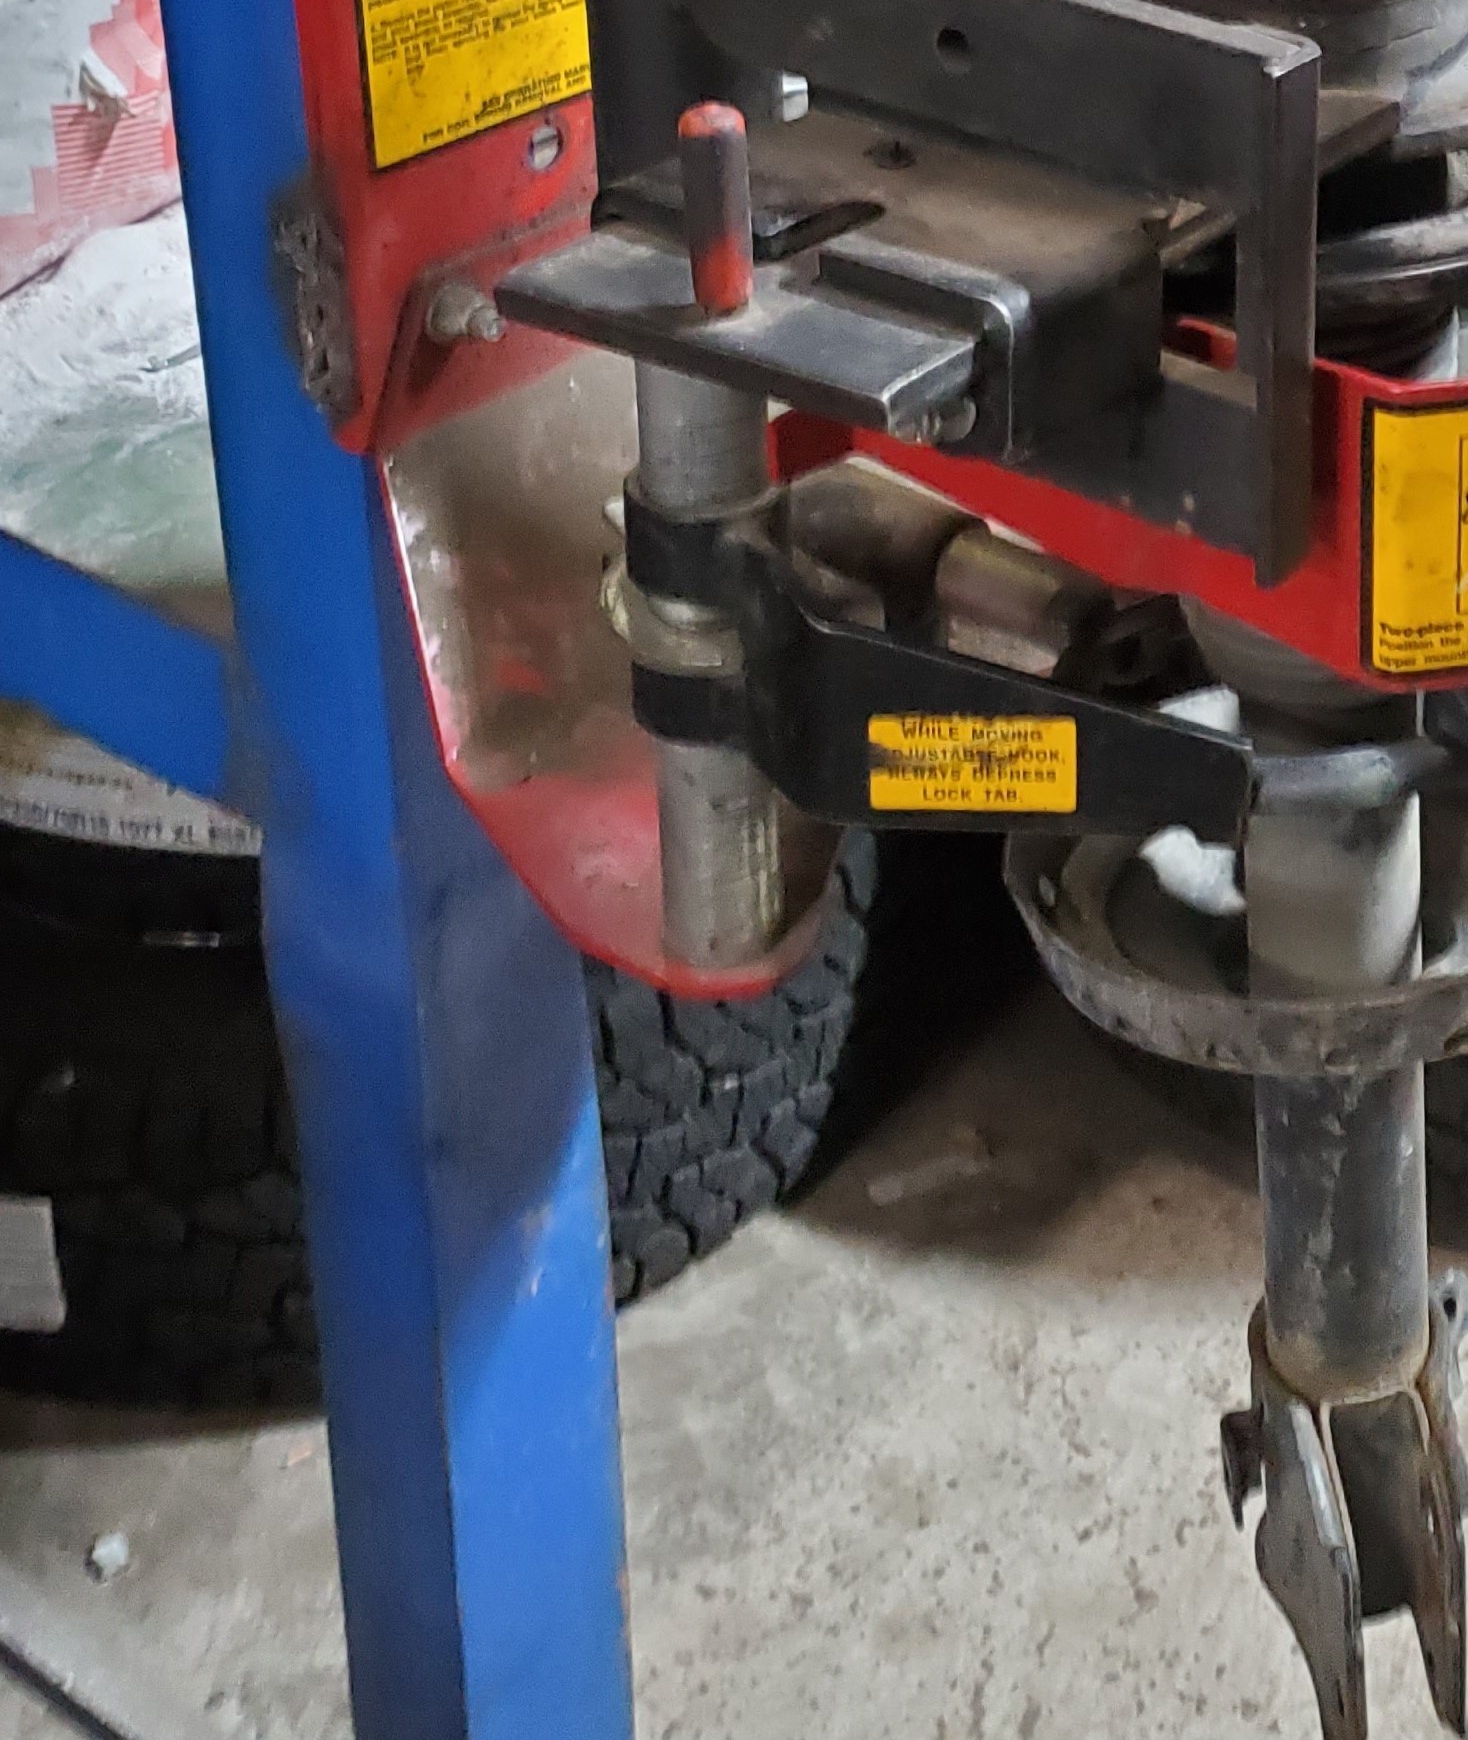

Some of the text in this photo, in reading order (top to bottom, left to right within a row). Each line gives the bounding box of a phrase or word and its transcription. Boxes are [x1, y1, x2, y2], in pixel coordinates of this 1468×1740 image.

[902, 718, 1043, 744] WHILE MOVING
[922, 787, 972, 803] LOCK
